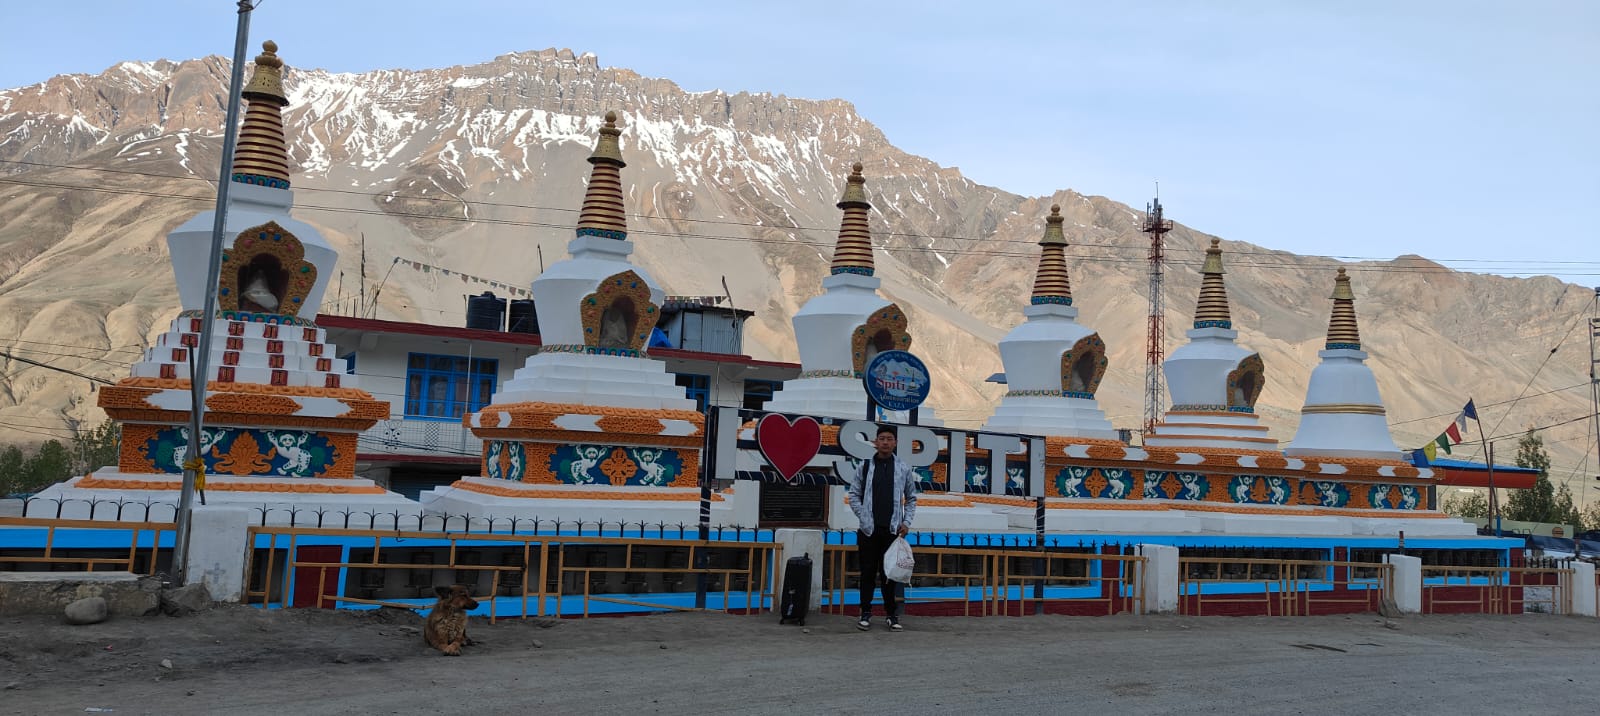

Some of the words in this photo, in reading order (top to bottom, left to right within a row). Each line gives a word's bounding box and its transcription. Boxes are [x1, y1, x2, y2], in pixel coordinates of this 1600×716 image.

[876, 375, 906, 393] Spiti
[715, 407, 738, 479] I
[835, 420, 1045, 498] SPITI
